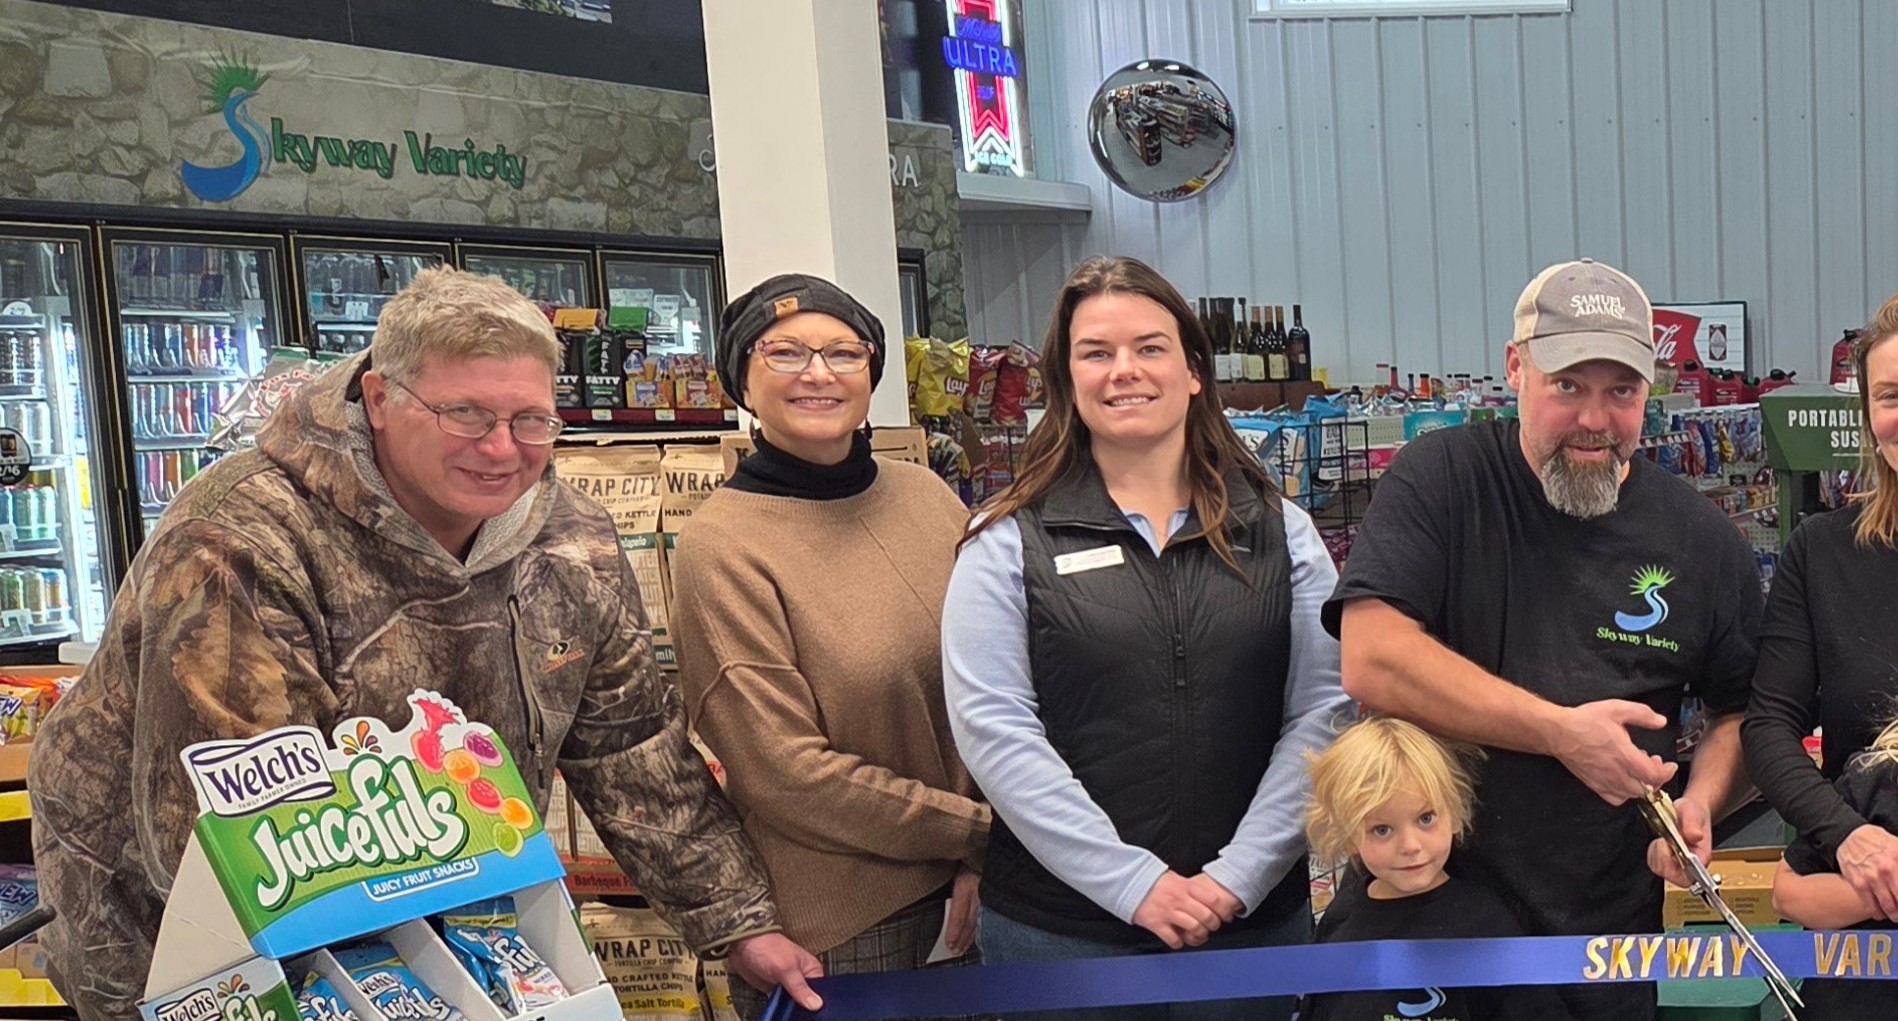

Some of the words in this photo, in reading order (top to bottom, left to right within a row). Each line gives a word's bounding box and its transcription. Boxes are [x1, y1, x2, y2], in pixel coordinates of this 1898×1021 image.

[945, 36, 1018, 76] ULTRA
[403, 130, 528, 190] Variety
[1570, 294, 1623, 311] SAMUEL
[1574, 304, 1626, 320] ADAMS
[621, 476, 661, 497] CITY
[664, 508, 693, 517] HAND
[615, 520, 635, 530] HIPS
[1596, 626, 1643, 646] Skyway
[1645, 633, 1680, 653] Variety
[203, 740, 322, 804] Welch's
[253, 756, 467, 908] Juicefuls
[371, 877, 402, 896] JUICY
[402, 868, 433, 888] FRUIT
[434, 858, 475, 879] SNACKS
[1583, 934, 1752, 979] SKYWAY
[621, 972, 669, 984] CRAFTED
[633, 998, 654, 1010] Salt
[656, 997, 685, 1009] Tortilla
